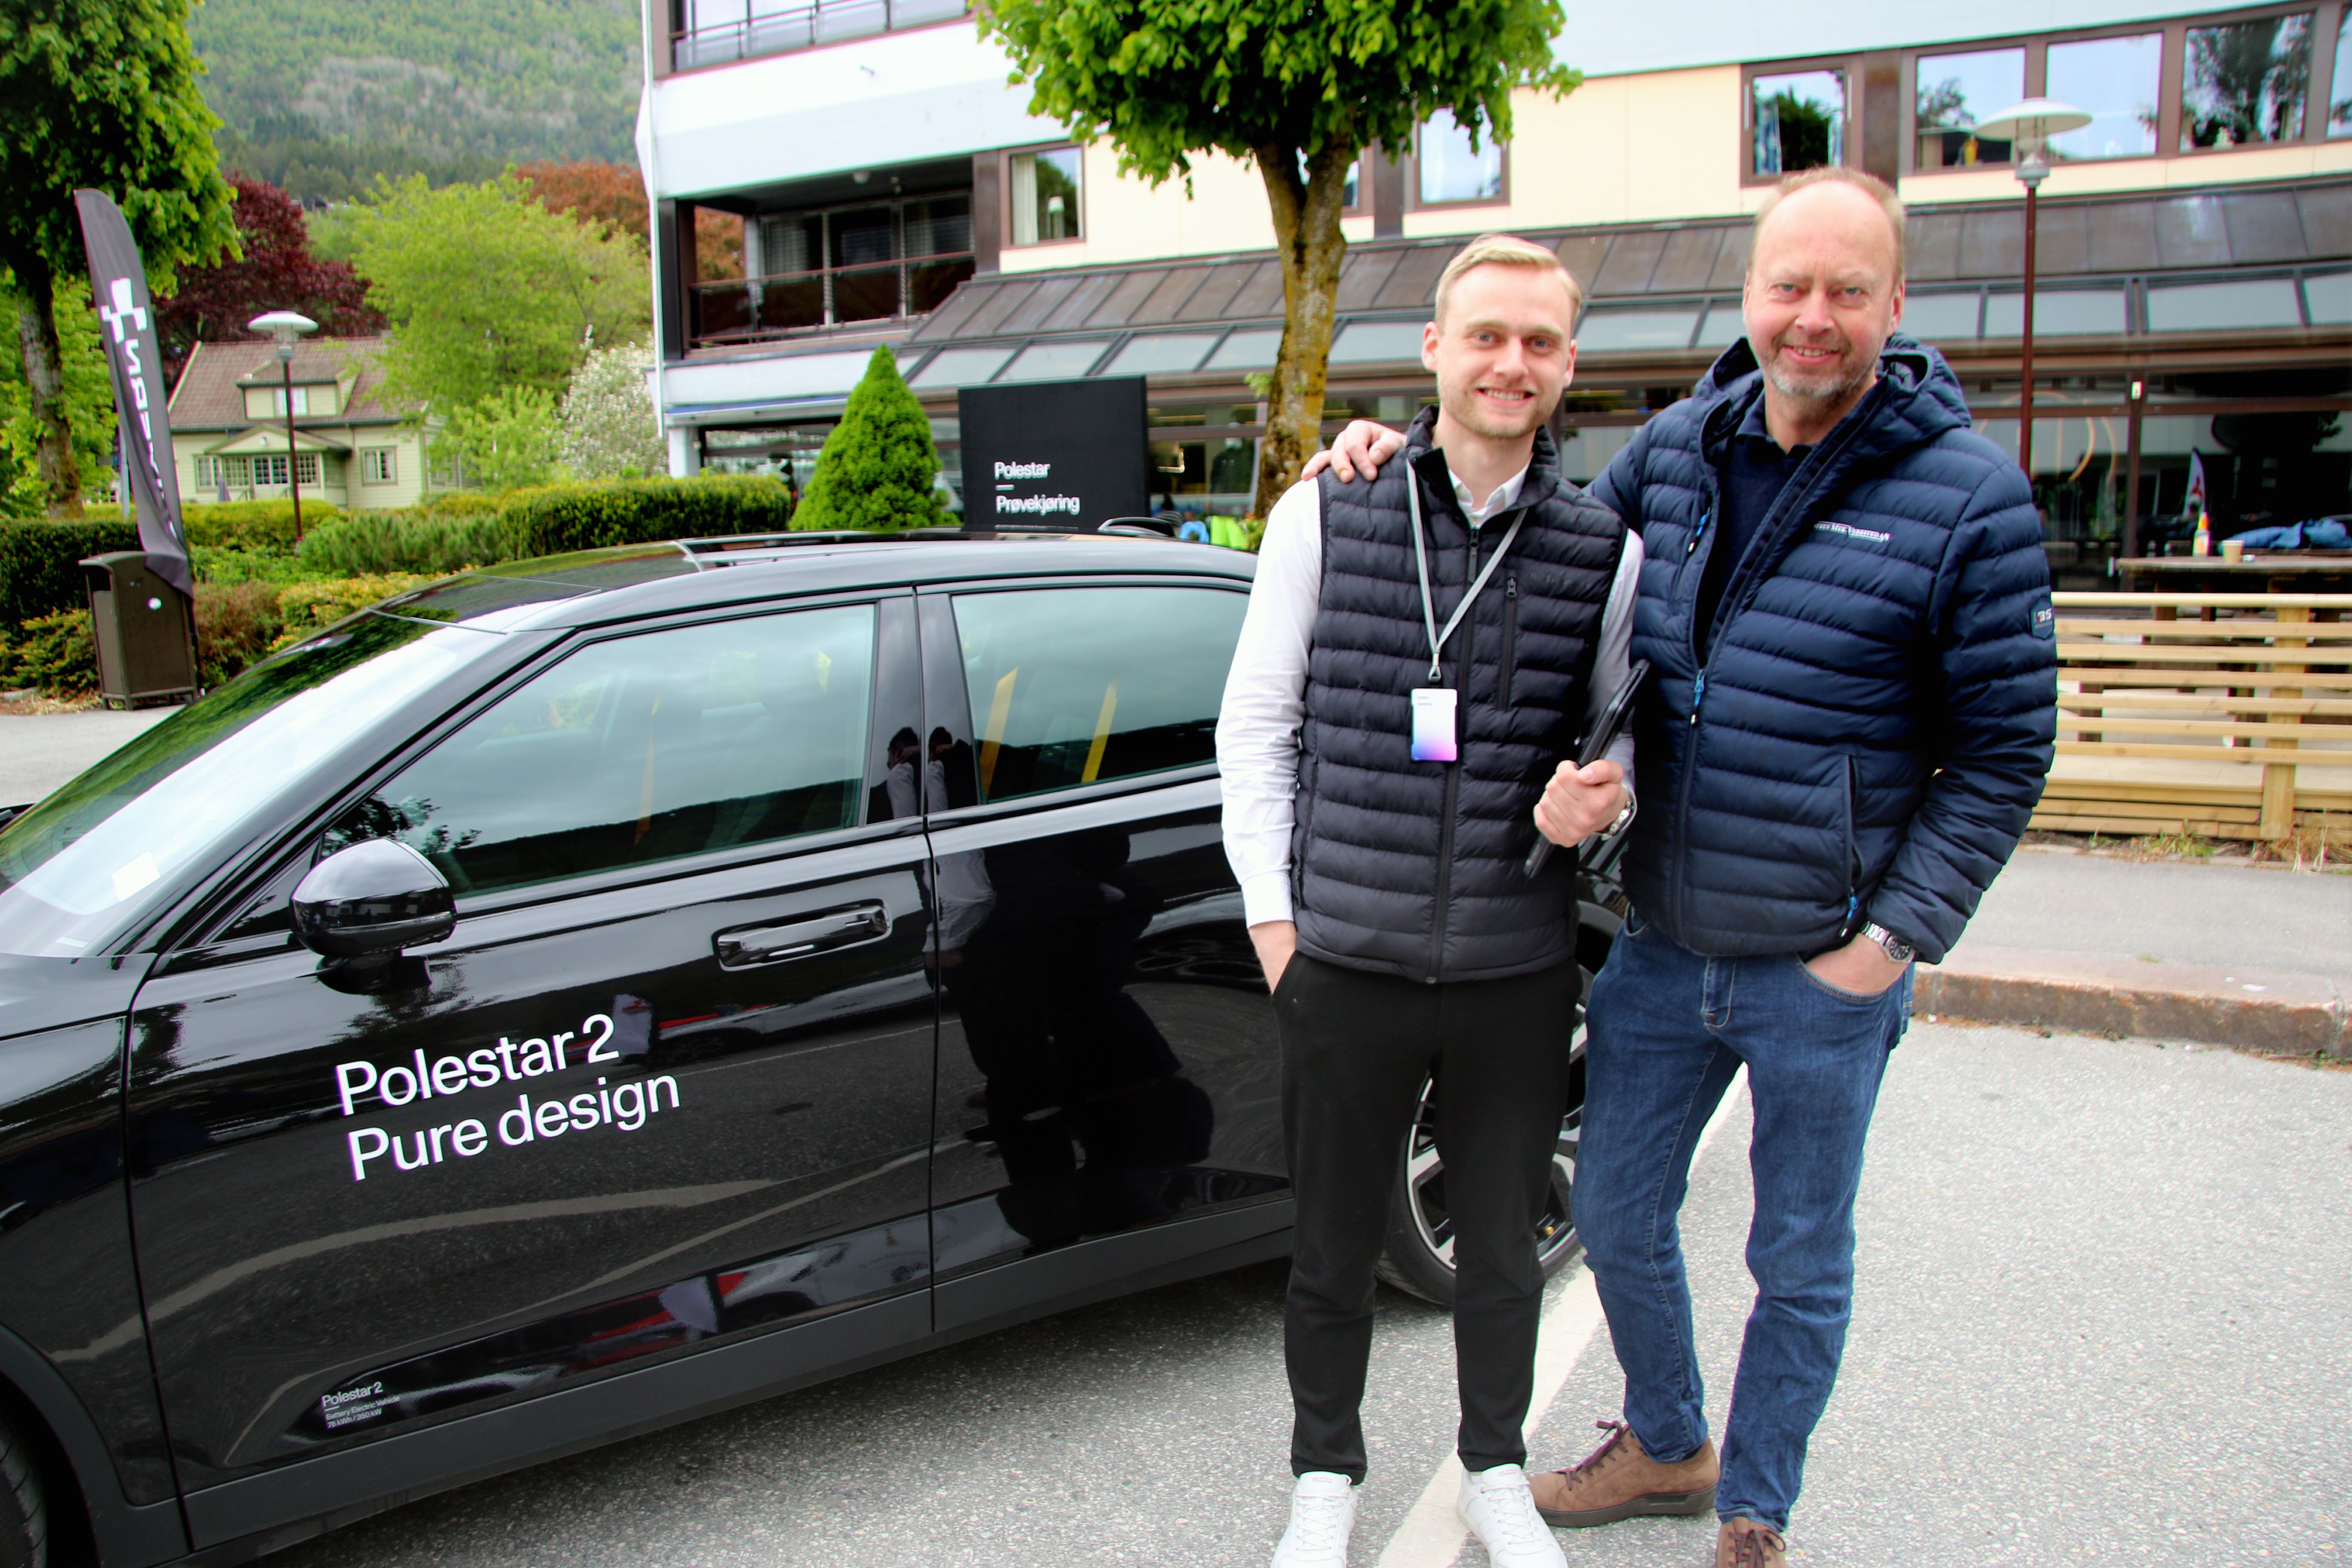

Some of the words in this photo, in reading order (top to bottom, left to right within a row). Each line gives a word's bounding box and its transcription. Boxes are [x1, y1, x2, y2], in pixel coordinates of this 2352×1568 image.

[994, 461, 1051, 480] Polestar
[996, 493, 1080, 516] Prøvekjøring
[336, 1032, 574, 1115] Polestar
[582, 1014, 619, 1063] 2
[348, 1127, 488, 1181] Pure
[499, 1075, 680, 1145] design
[322, 1386, 372, 1407] Polestar
[373, 1381, 383, 1393] 2
[326, 1410, 350, 1420] Battery
[351, 1402, 376, 1413] Electric
[375, 1396, 400, 1406] Vehicle
[337, 1416, 352, 1426] kWh
[356, 1412, 370, 1420] 350
[371, 1408, 382, 1417] kW
